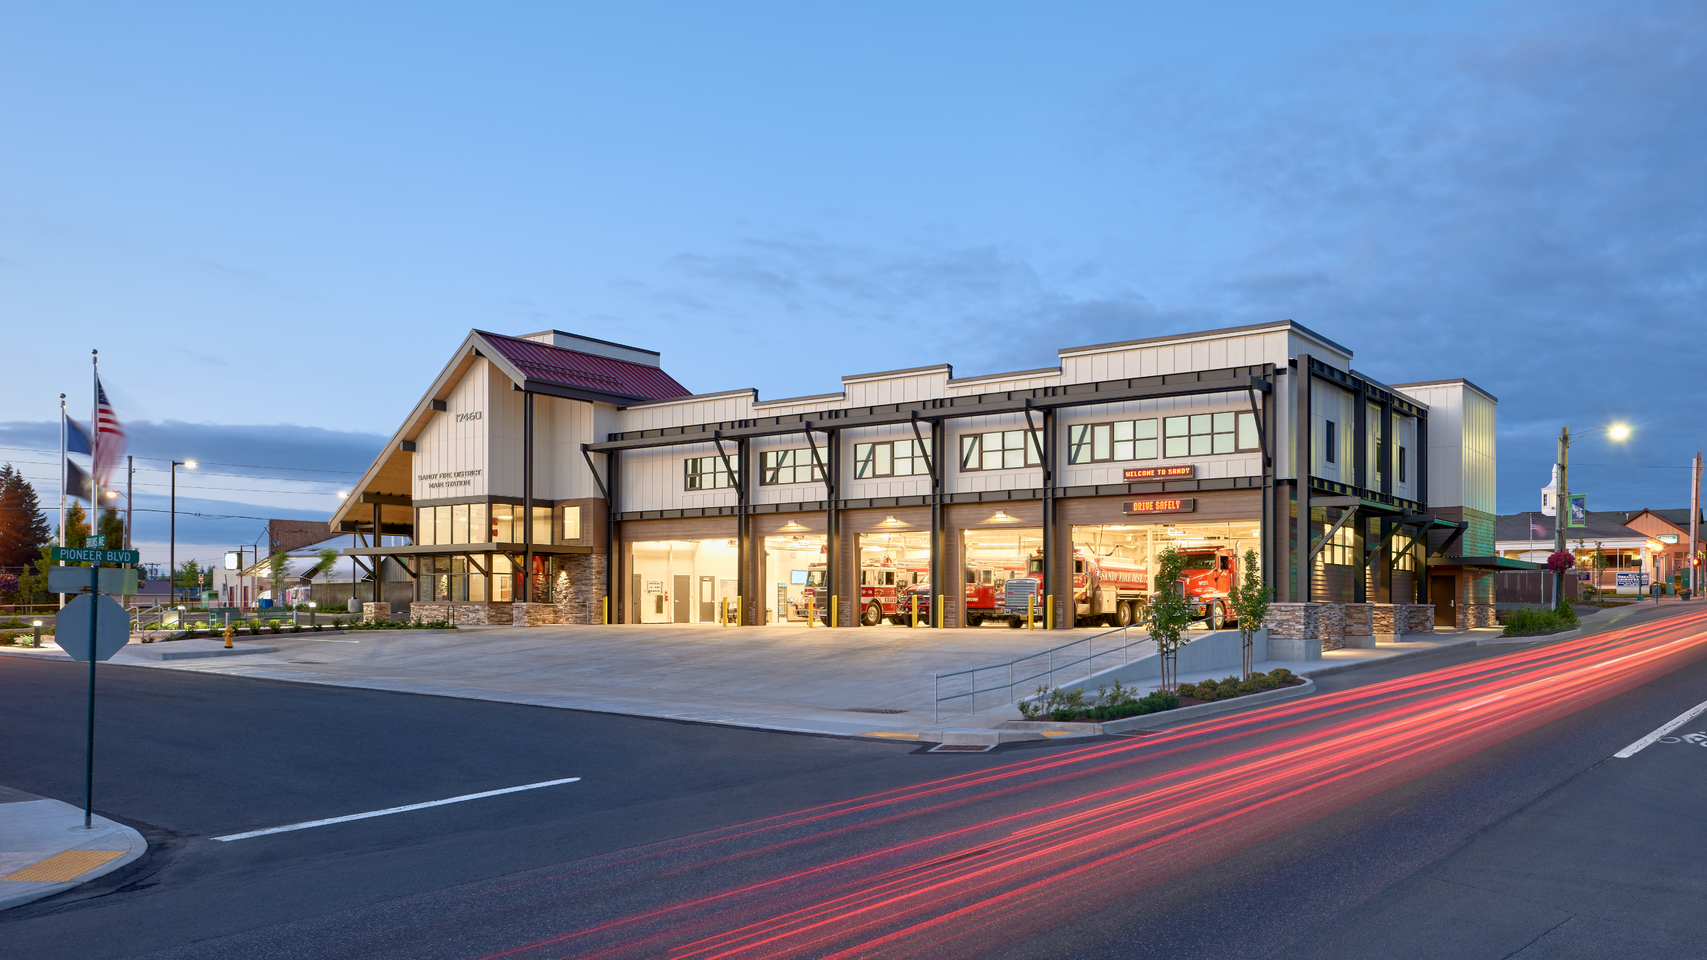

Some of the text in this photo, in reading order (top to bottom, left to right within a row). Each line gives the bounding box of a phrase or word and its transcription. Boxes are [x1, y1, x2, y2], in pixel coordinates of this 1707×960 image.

[456, 411, 482, 422] 17460
[418, 473, 438, 481] SANDY
[454, 470, 482, 478] DISTRICT
[445, 480, 471, 488] STATION
[1133, 500, 1181, 511] DRIVE SAFELY
[60, 549, 131, 562] PIONEER BLVD
[1102, 570, 1118, 582] SANDY
[1118, 572, 1132, 582] FIRE
